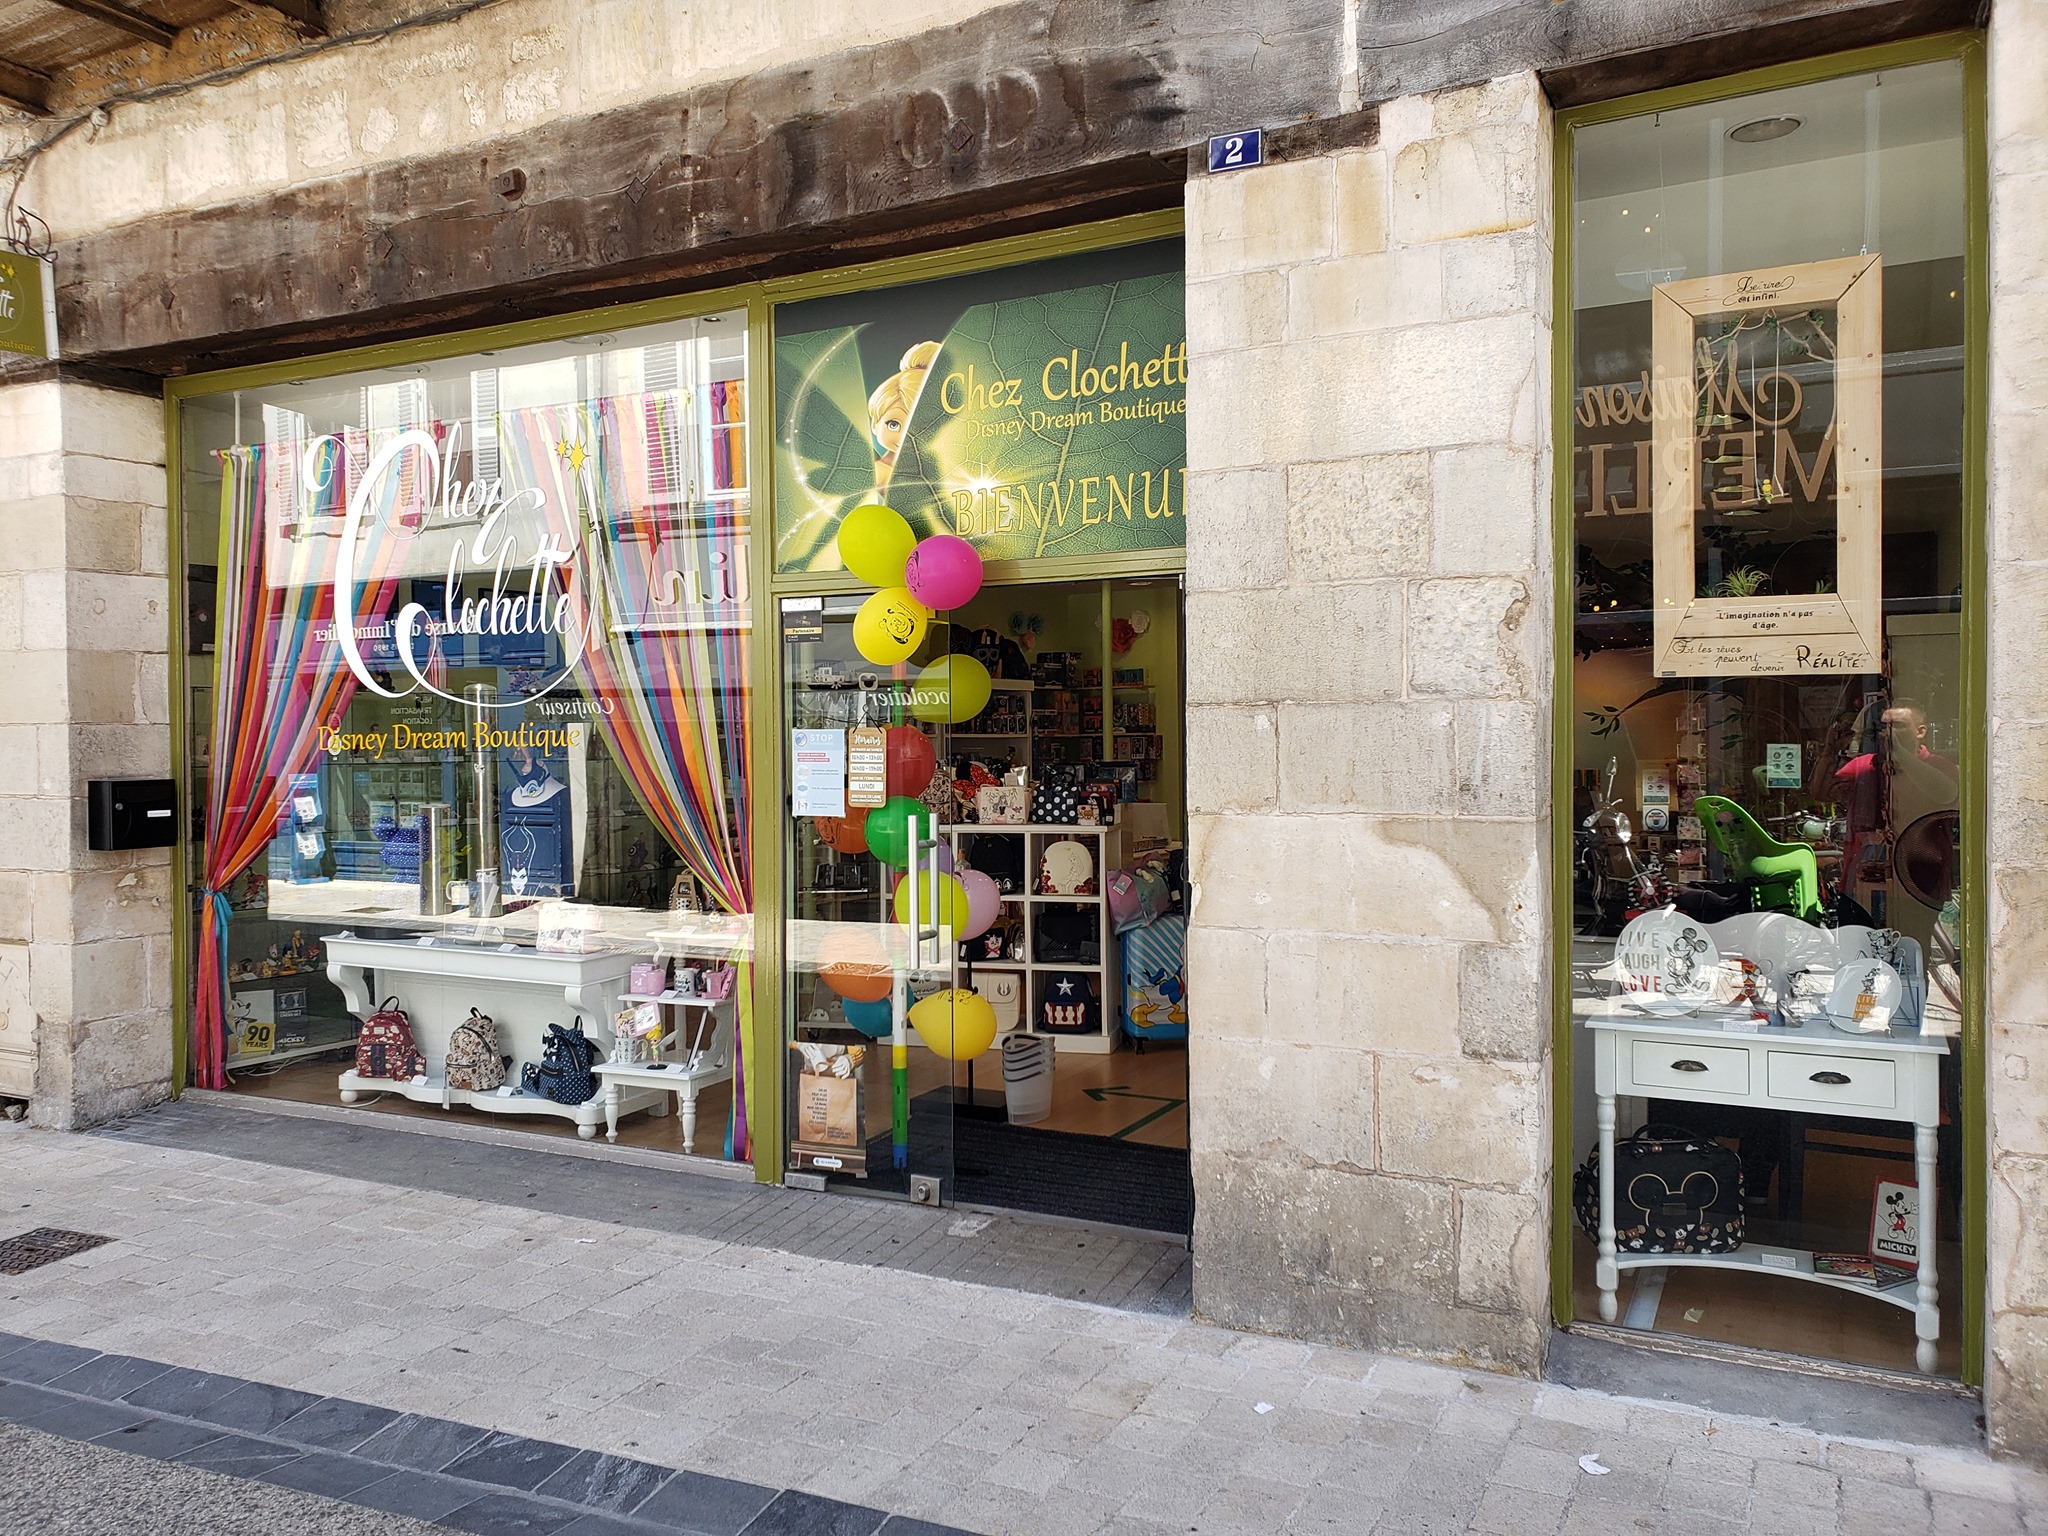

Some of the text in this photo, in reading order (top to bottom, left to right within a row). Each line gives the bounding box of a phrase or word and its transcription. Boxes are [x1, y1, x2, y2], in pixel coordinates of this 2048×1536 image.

[1225, 137, 1243, 165] 2
[940, 364, 1023, 414] Chez
[965, 397, 1187, 441] Disney Dream Boutique
[1718, 611, 1780, 621] L'imagination
[1798, 610, 1814, 619] pas
[1697, 643, 1712, 653] les
[1714, 653, 1762, 668] peuvent
[1750, 662, 1785, 672] devenir
[318, 721, 581, 759] Disney Dream Boutique
[810, 734, 833, 742] STOP
[1619, 931, 1660, 949] LIVE
[248, 1026, 270, 1041] 90
[1879, 1240, 1915, 1255] MICKEY
